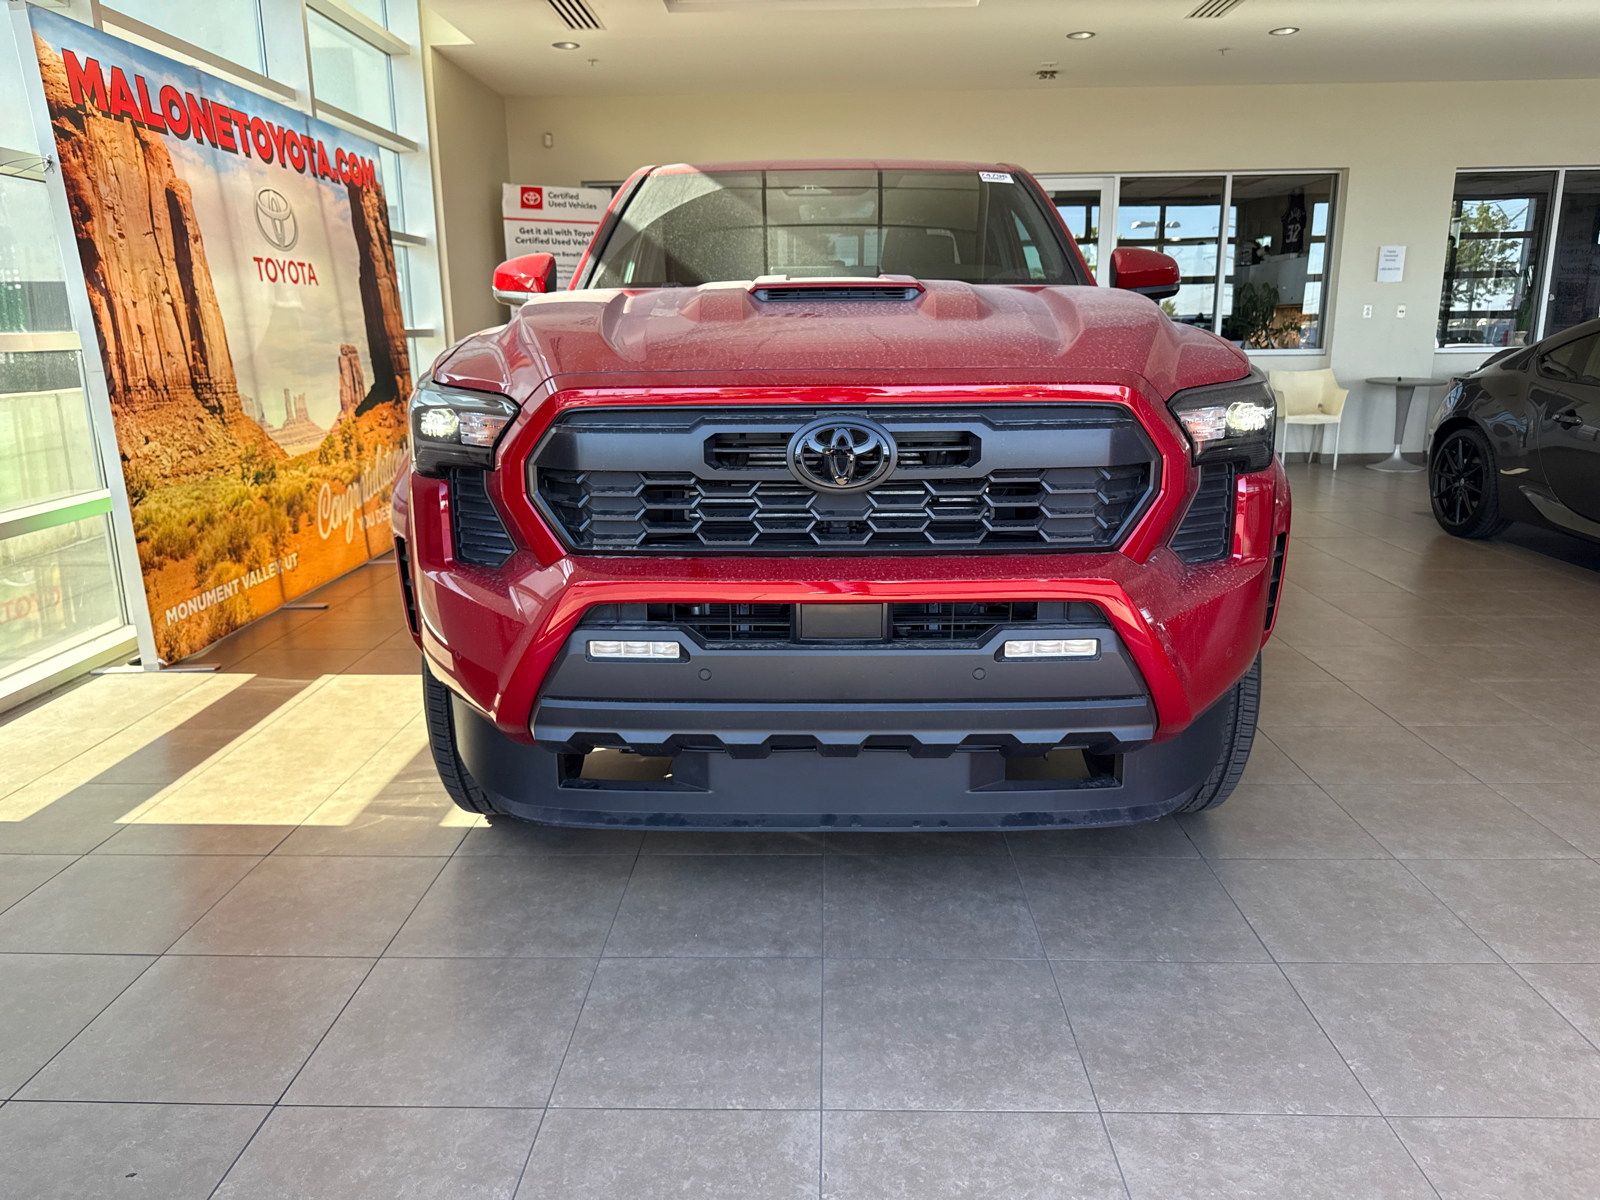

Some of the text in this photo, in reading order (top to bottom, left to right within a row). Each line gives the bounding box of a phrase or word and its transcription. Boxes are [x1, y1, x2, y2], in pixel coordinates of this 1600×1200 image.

[61, 47, 378, 192] MALONETOYOTA.COM
[548, 192, 579, 200] Certified
[548, 200, 597, 210] Used Vehicles
[519, 227, 535, 235] Get
[543, 228, 554, 236] all
[555, 228, 572, 237] with
[574, 229, 594, 238] Toyot
[1286, 223, 1301, 243] 32
[515, 236, 590, 247] Certified Used Vehi
[252, 256, 319, 286] TOYOTA
[165, 578, 240, 627] MONUMENT
[284, 552, 299, 571] UT
